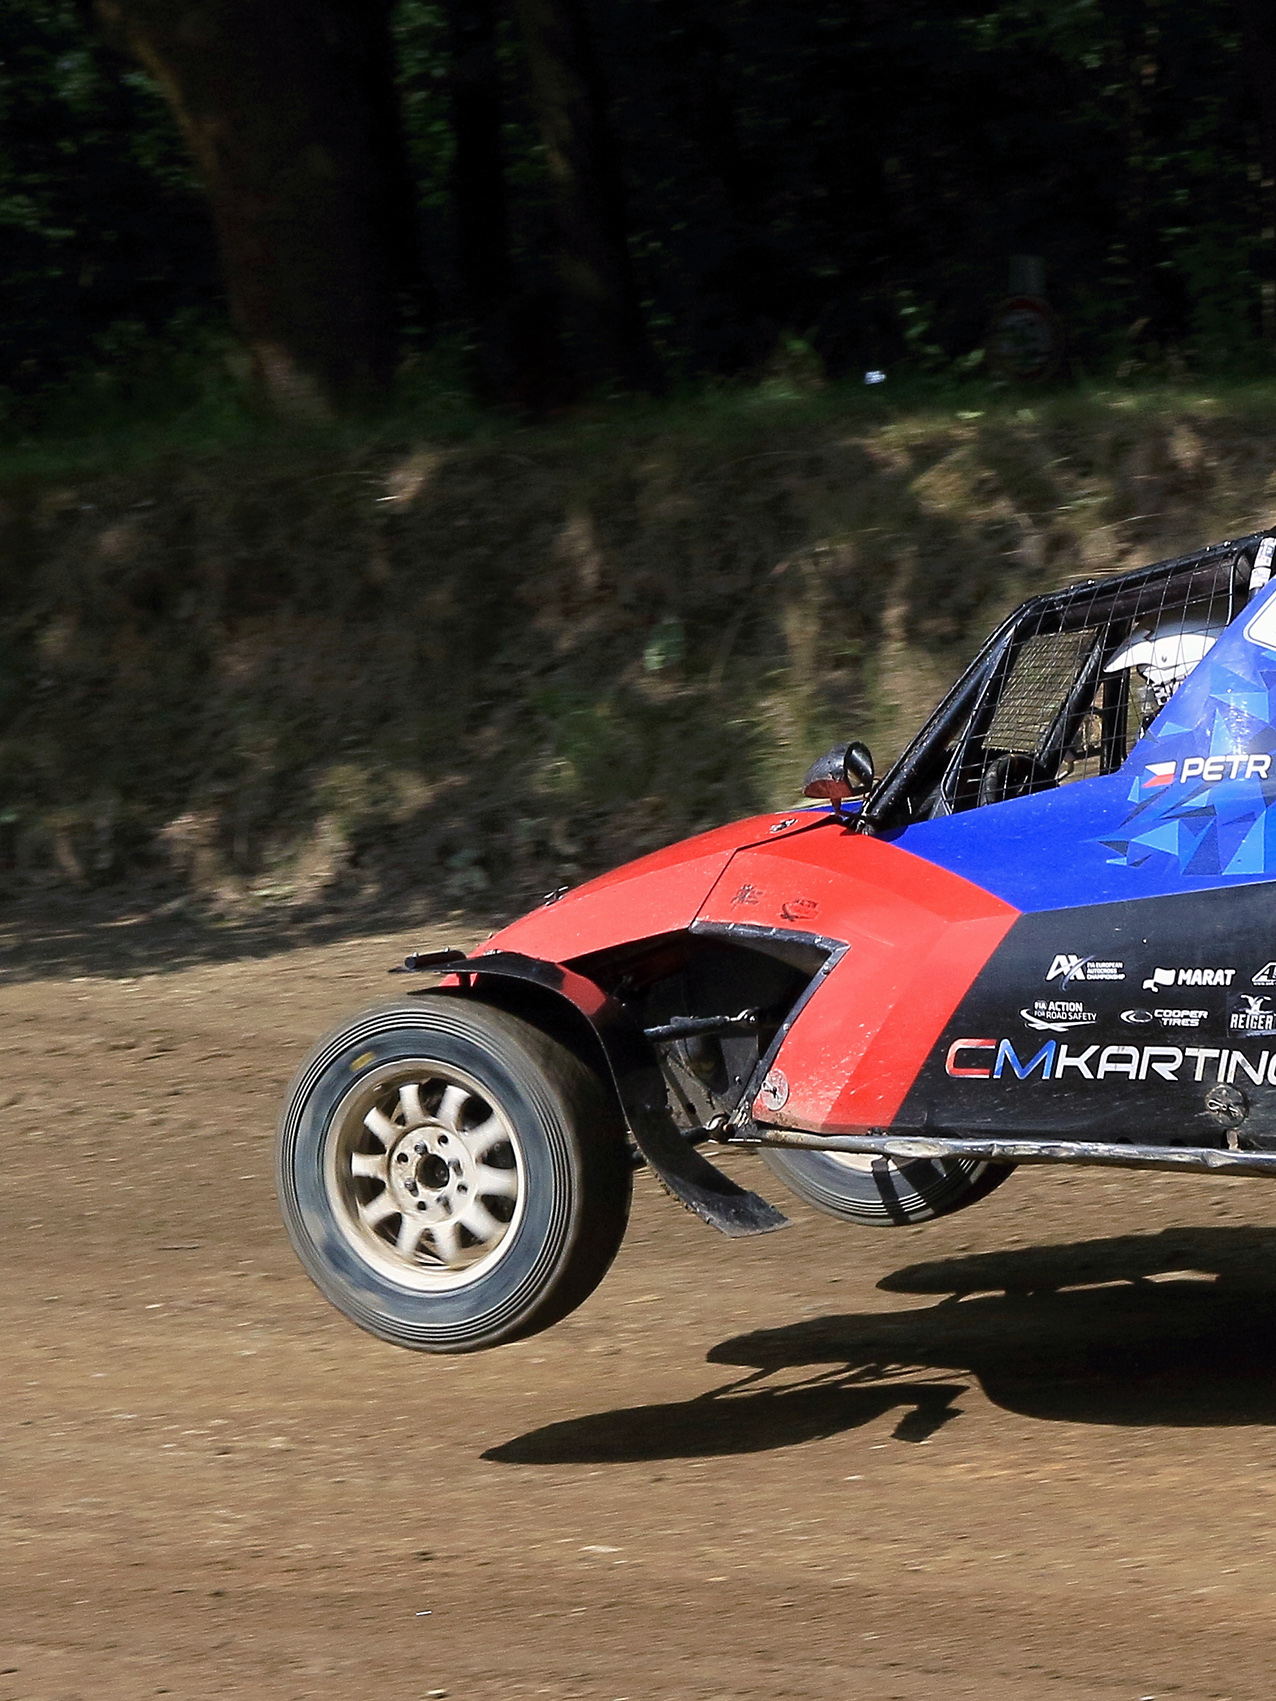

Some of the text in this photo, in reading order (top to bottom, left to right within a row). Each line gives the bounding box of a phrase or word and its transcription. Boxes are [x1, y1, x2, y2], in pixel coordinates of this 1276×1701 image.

[1180, 754, 1272, 784] PETR
[1177, 968, 1236, 986] MARAT
[1034, 1001, 1084, 1013] FIA ACTION
[1045, 1010, 1068, 1020] ROAD
[1067, 1012, 1097, 1021] SAFETY
[1153, 1008, 1209, 1019] COOPER
[1161, 1018, 1200, 1027] TIRES
[1229, 1013, 1275, 1030] REIGER
